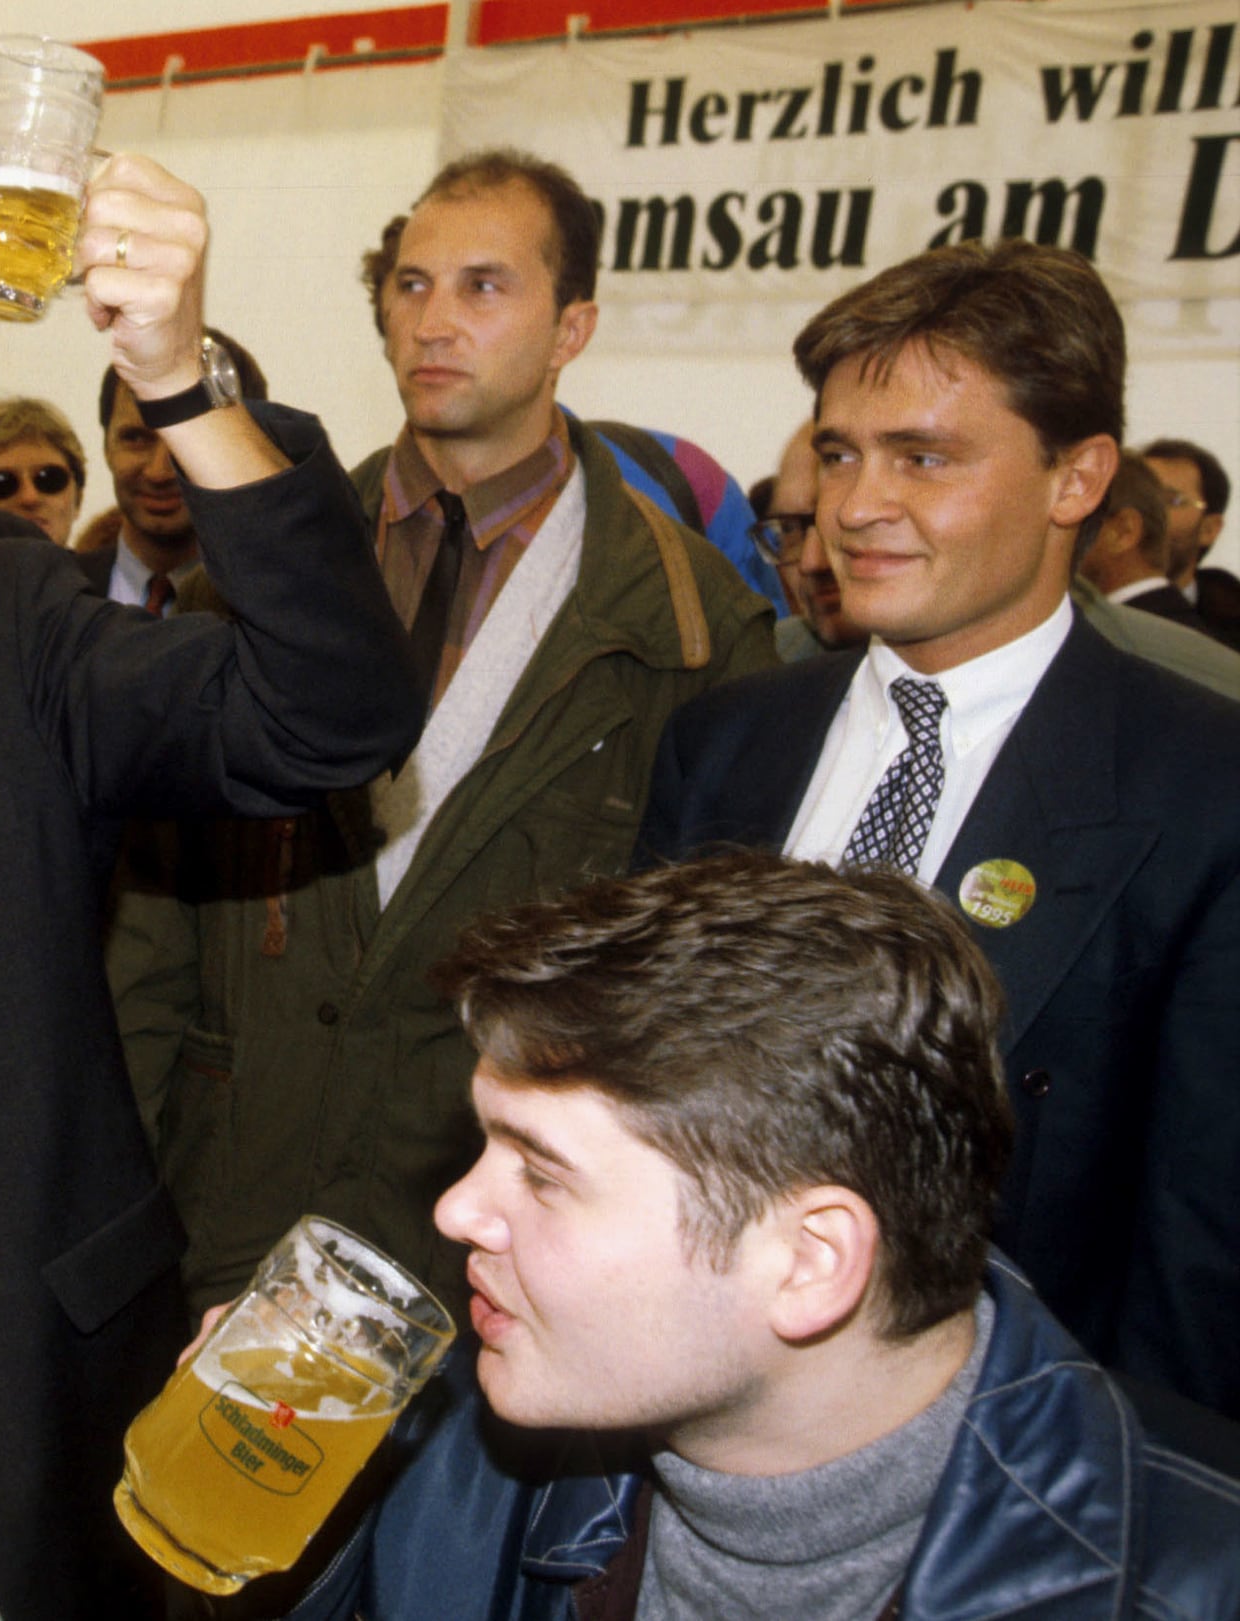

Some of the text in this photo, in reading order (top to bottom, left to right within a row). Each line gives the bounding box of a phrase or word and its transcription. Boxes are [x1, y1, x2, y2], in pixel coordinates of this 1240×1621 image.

[625, 22, 1240, 148] Herzlich will
[594, 187, 874, 273] msau
[928, 176, 1106, 262] am
[970, 902, 1015, 925] 1995
[215, 1395, 311, 1477] Schladminger
[231, 1440, 265, 1473] Bier
